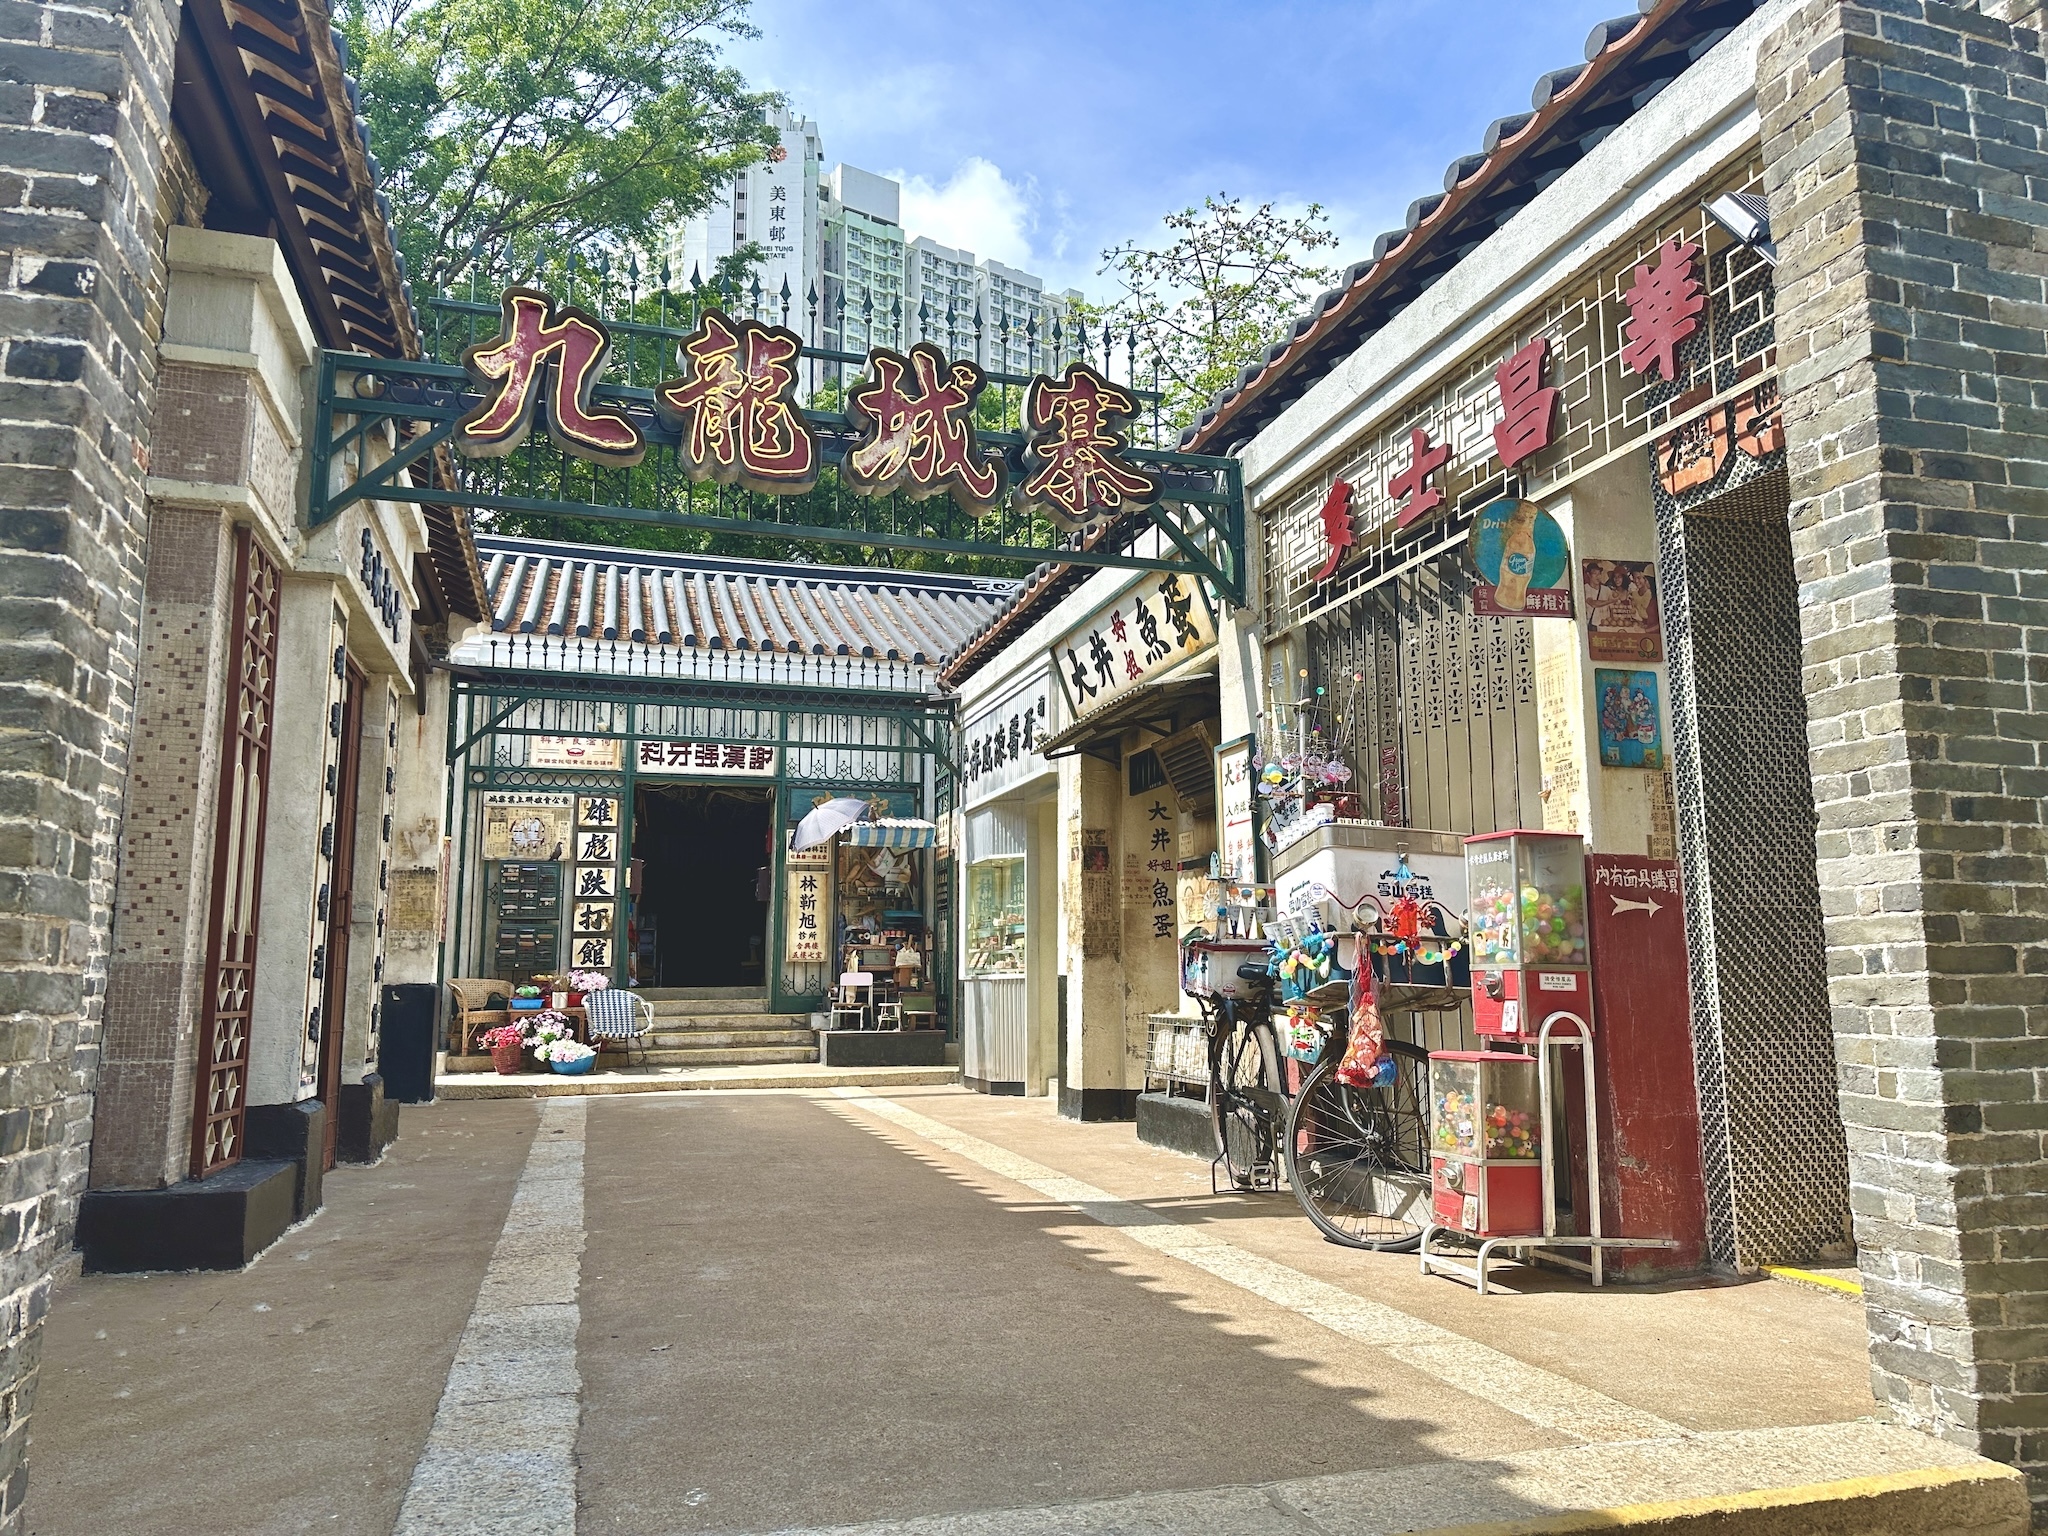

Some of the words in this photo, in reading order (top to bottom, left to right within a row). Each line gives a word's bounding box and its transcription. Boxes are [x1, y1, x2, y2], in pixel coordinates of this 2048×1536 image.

[769, 185, 786, 242] 美東邨
[457, 290, 1157, 522] 九龍城寨
[1312, 240, 1711, 582] 華昌士多
[1526, 593, 1571, 612] 鮮橙汁
[576, 797, 613, 968] 雄彪跌打館
[798, 875, 818, 929] 林靳旭
[1377, 882, 1435, 901] 雪山雪糕
[1595, 864, 1679, 895] 內有面具購買
